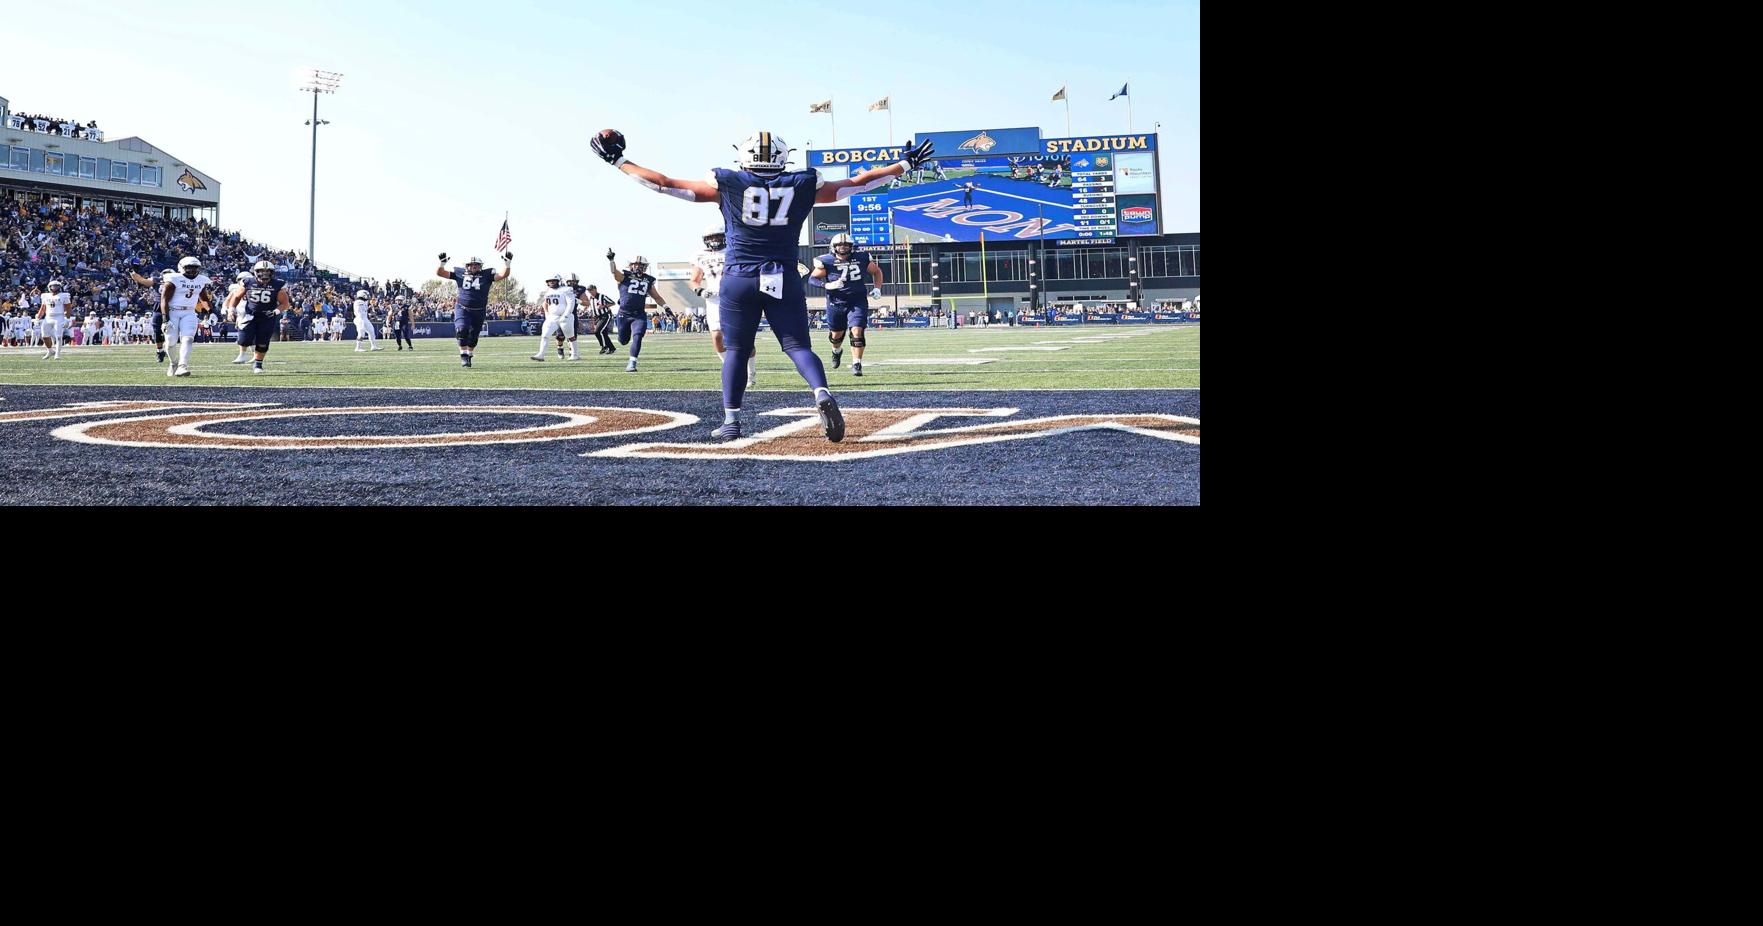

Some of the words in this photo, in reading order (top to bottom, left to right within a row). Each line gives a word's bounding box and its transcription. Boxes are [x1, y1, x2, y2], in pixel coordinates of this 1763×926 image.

[37, 122, 46, 131] 52
[1046, 136, 1147, 153] STADIUM
[822, 148, 902, 163] BOBCAT
[741, 186, 795, 226] 87
[857, 203, 882, 211] 9:56
[893, 198, 1076, 239] MON
[837, 264, 862, 281] 72
[462, 276, 481, 290] 64
[627, 279, 648, 296] 23
[185, 288, 194, 299] 3
[250, 290, 272, 304] 56
